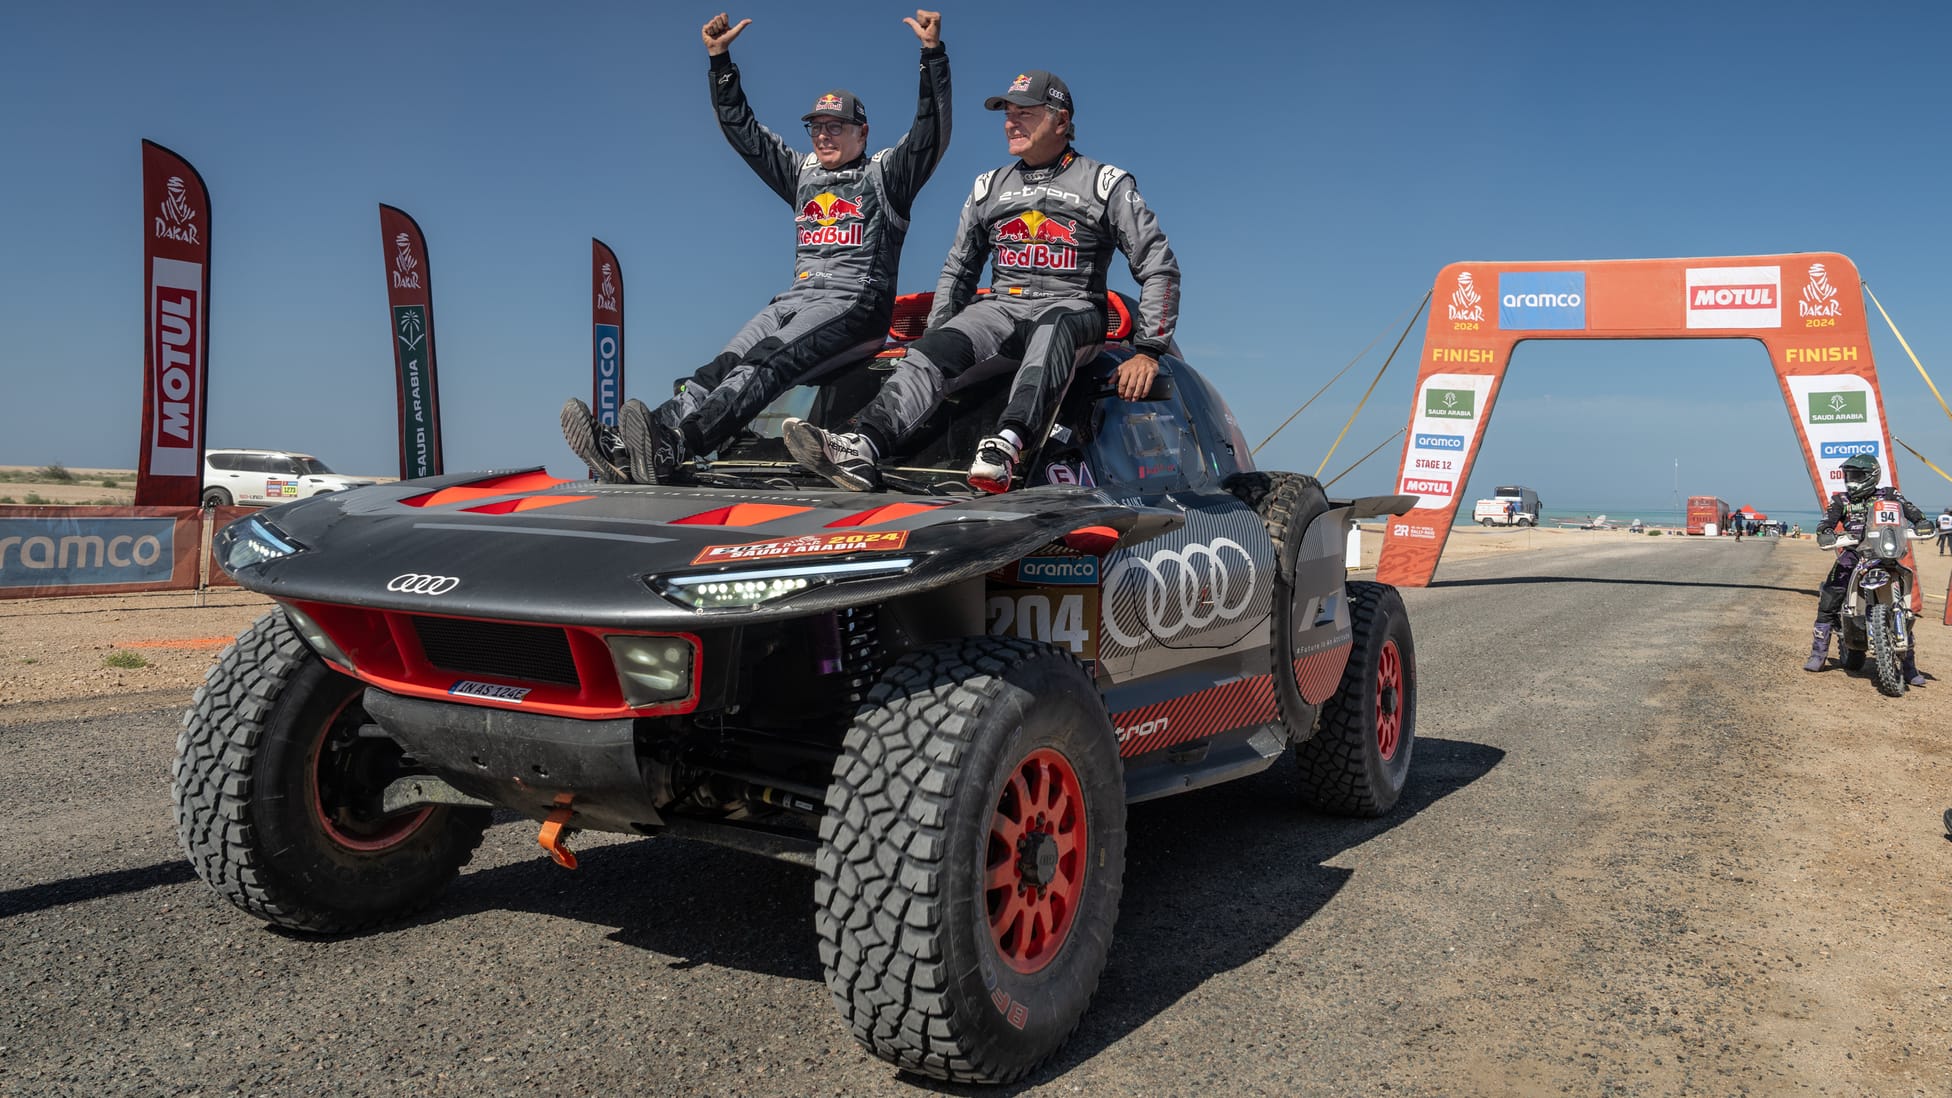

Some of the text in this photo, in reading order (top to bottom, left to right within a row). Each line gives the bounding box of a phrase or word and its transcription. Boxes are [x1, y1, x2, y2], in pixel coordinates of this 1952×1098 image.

[155, 216, 200, 245] DAKAR
[393, 270, 421, 289] DAKAR
[1503, 293, 1581, 308] aramco
[1694, 288, 1772, 306] MOTUL
[1448, 304, 1485, 322] DAKAR
[1799, 299, 1842, 317] DAKAR
[1453, 322, 1479, 331] 2024
[1805, 318, 1835, 328] 2024
[1432, 348, 1494, 363] FINISH
[1786, 346, 1858, 362] FINISH
[161, 296, 192, 441] MOTUL
[600, 337, 616, 427] amco
[408, 359, 427, 477] SAUDI ARABIA
[1448, 409, 1471, 417] ARABIA
[1835, 413, 1864, 421] ARABIA
[1418, 437, 1461, 448] aramco
[1824, 444, 1875, 455] aramco
[1415, 459, 1452, 470] STAGE 12
[1406, 480, 1449, 493] MOTUL
[1880, 512, 1896, 523] 94
[828, 533, 899, 545] 2024
[0, 535, 160, 569] ramco
[730, 546, 790, 558] SAUDI
[793, 542, 867, 553] ARABIA
[1024, 563, 1094, 576] aramco
[988, 594, 1089, 652] 204
[476, 684, 493, 695] AS
[1115, 717, 1168, 742] tron
